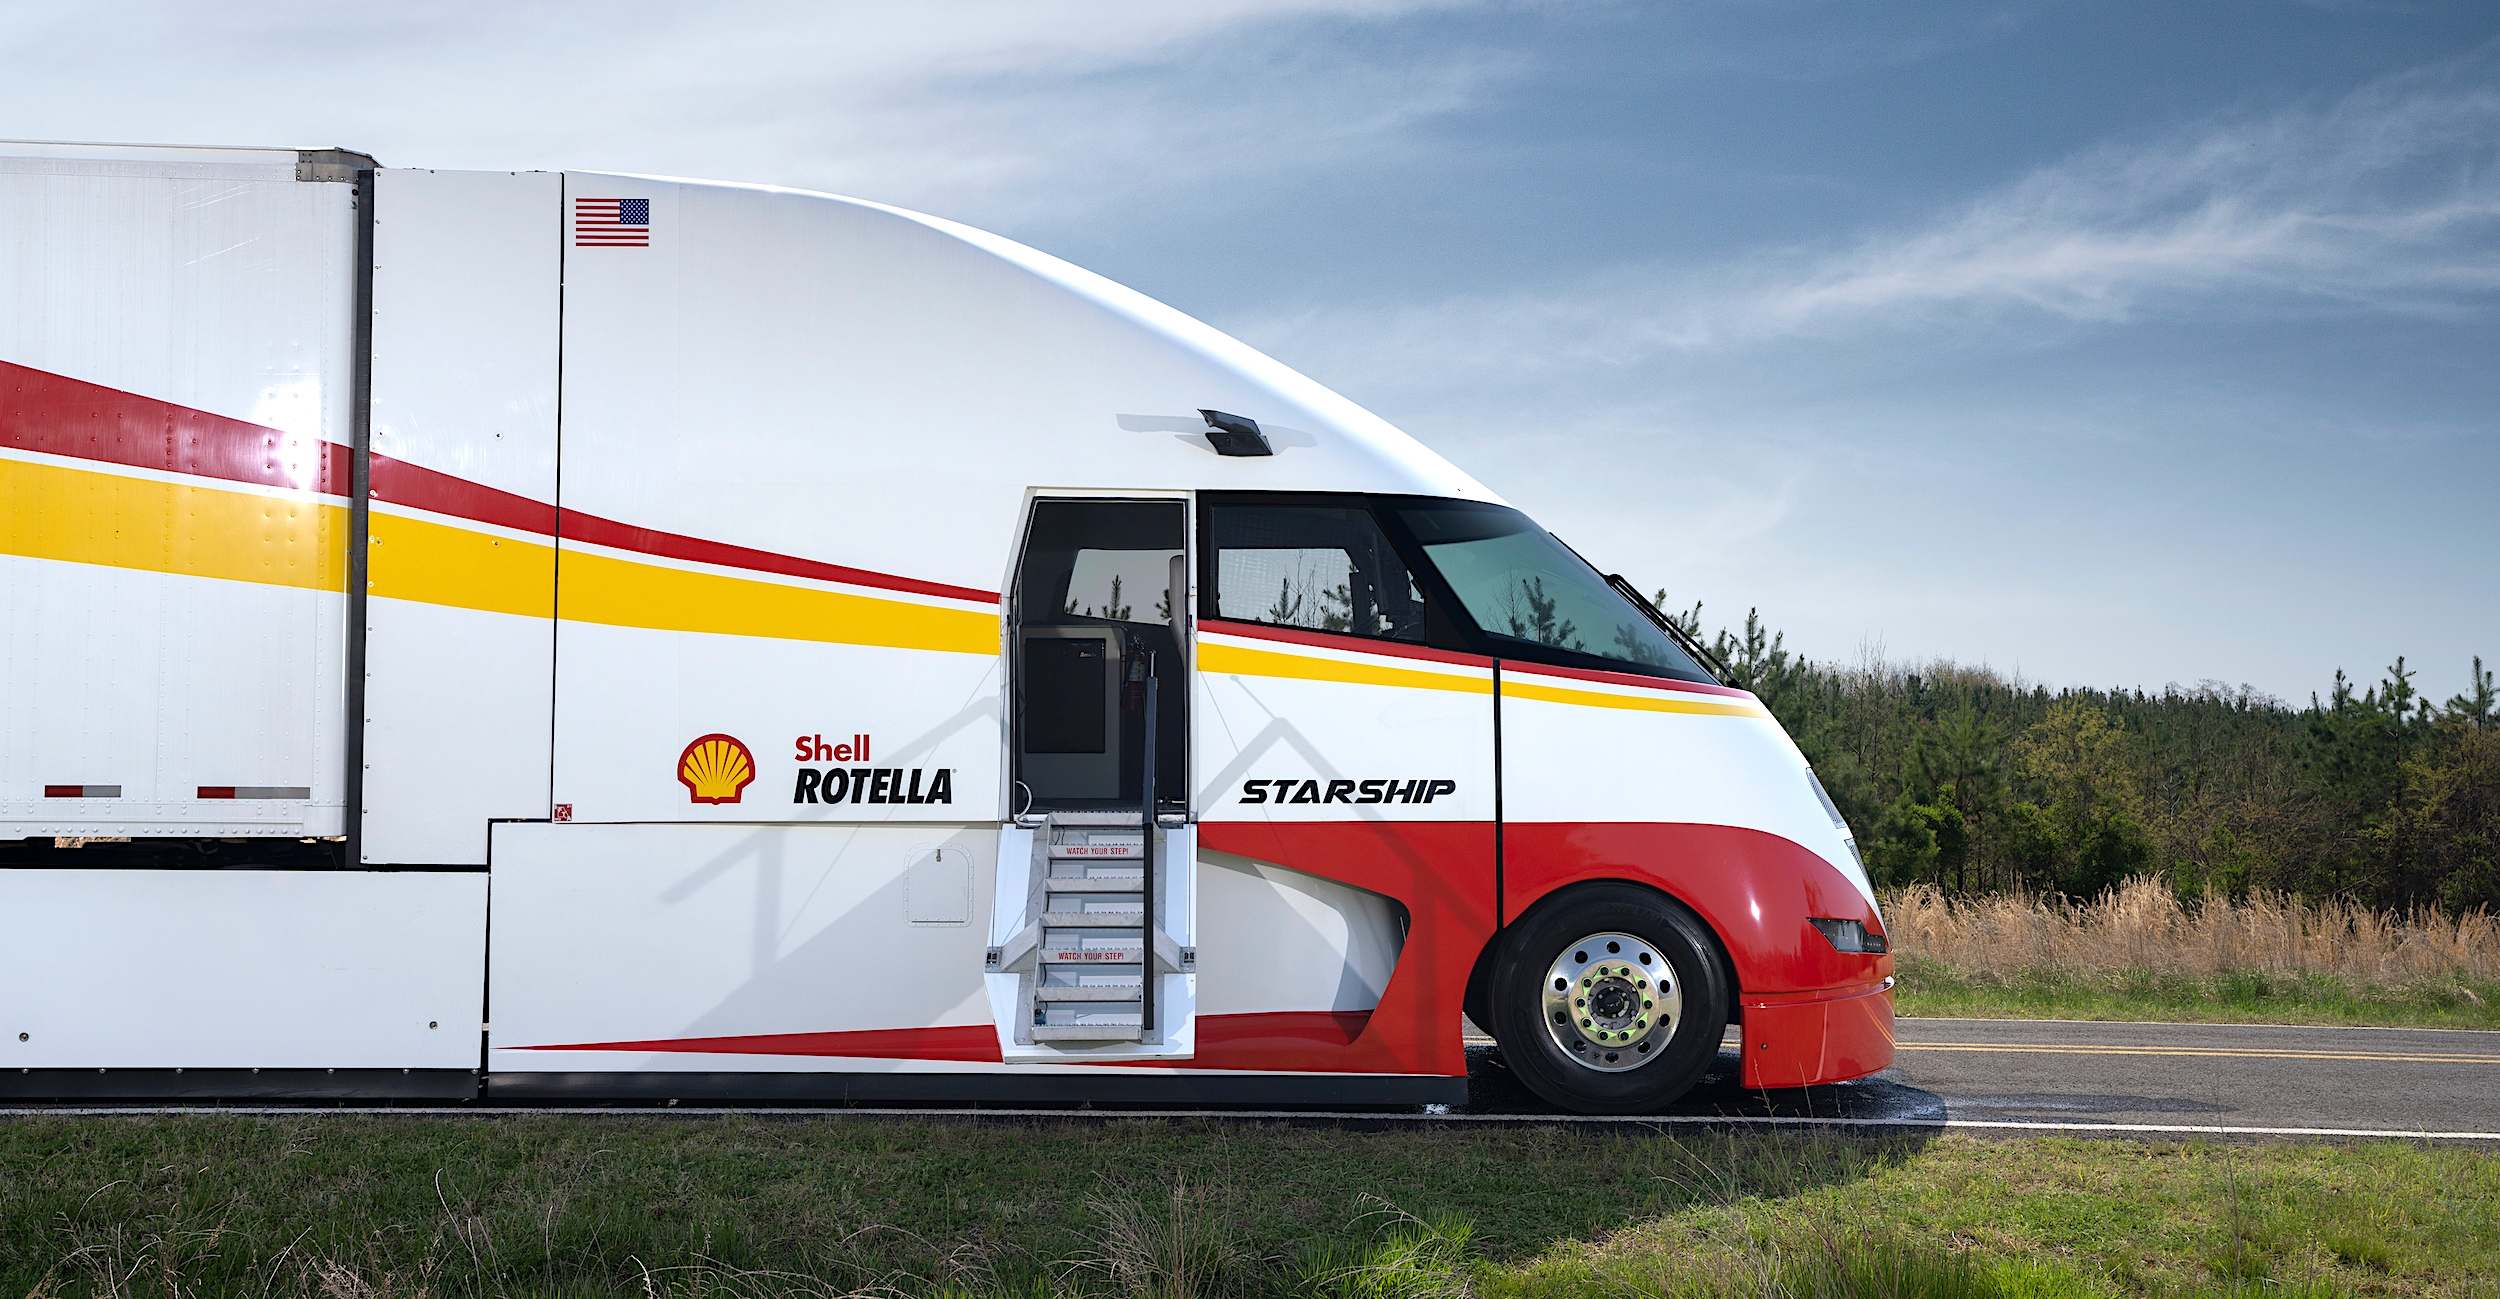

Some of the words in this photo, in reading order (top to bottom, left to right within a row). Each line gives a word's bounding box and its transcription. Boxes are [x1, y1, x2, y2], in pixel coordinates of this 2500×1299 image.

[795, 734, 869, 761] Shell
[794, 768, 952, 804] ROTELLA
[1238, 780, 1456, 803] STARSHIP
[1066, 847, 1089, 855] WATCH
[1091, 847, 1108, 855] YOUR
[1110, 847, 1129, 855] STEP!
[1058, 952, 1082, 960] WATCH
[1084, 952, 1102, 960] YOUR
[1105, 952, 1124, 960] STEP!
